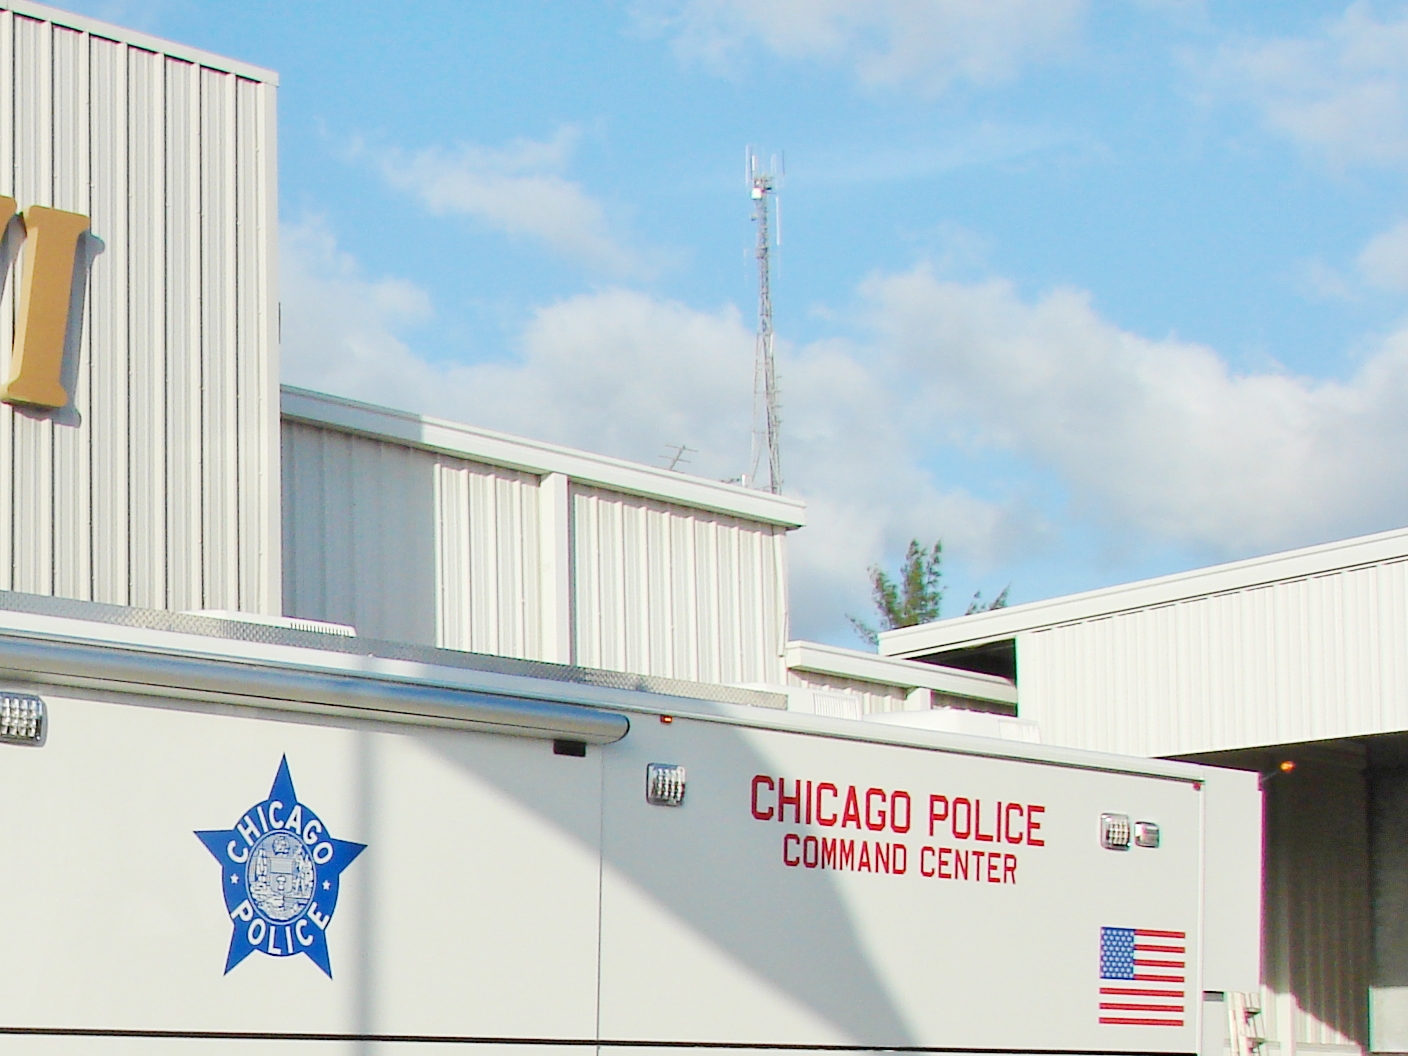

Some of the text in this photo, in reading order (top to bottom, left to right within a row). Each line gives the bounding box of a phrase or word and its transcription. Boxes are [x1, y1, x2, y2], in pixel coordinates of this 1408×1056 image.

[227, 800, 334, 865] CHICAGO
[751, 774, 1046, 847] CHICAGO POLICE
[783, 833, 1018, 885] COMMAND CENTER
[230, 899, 330, 955] POLICE
